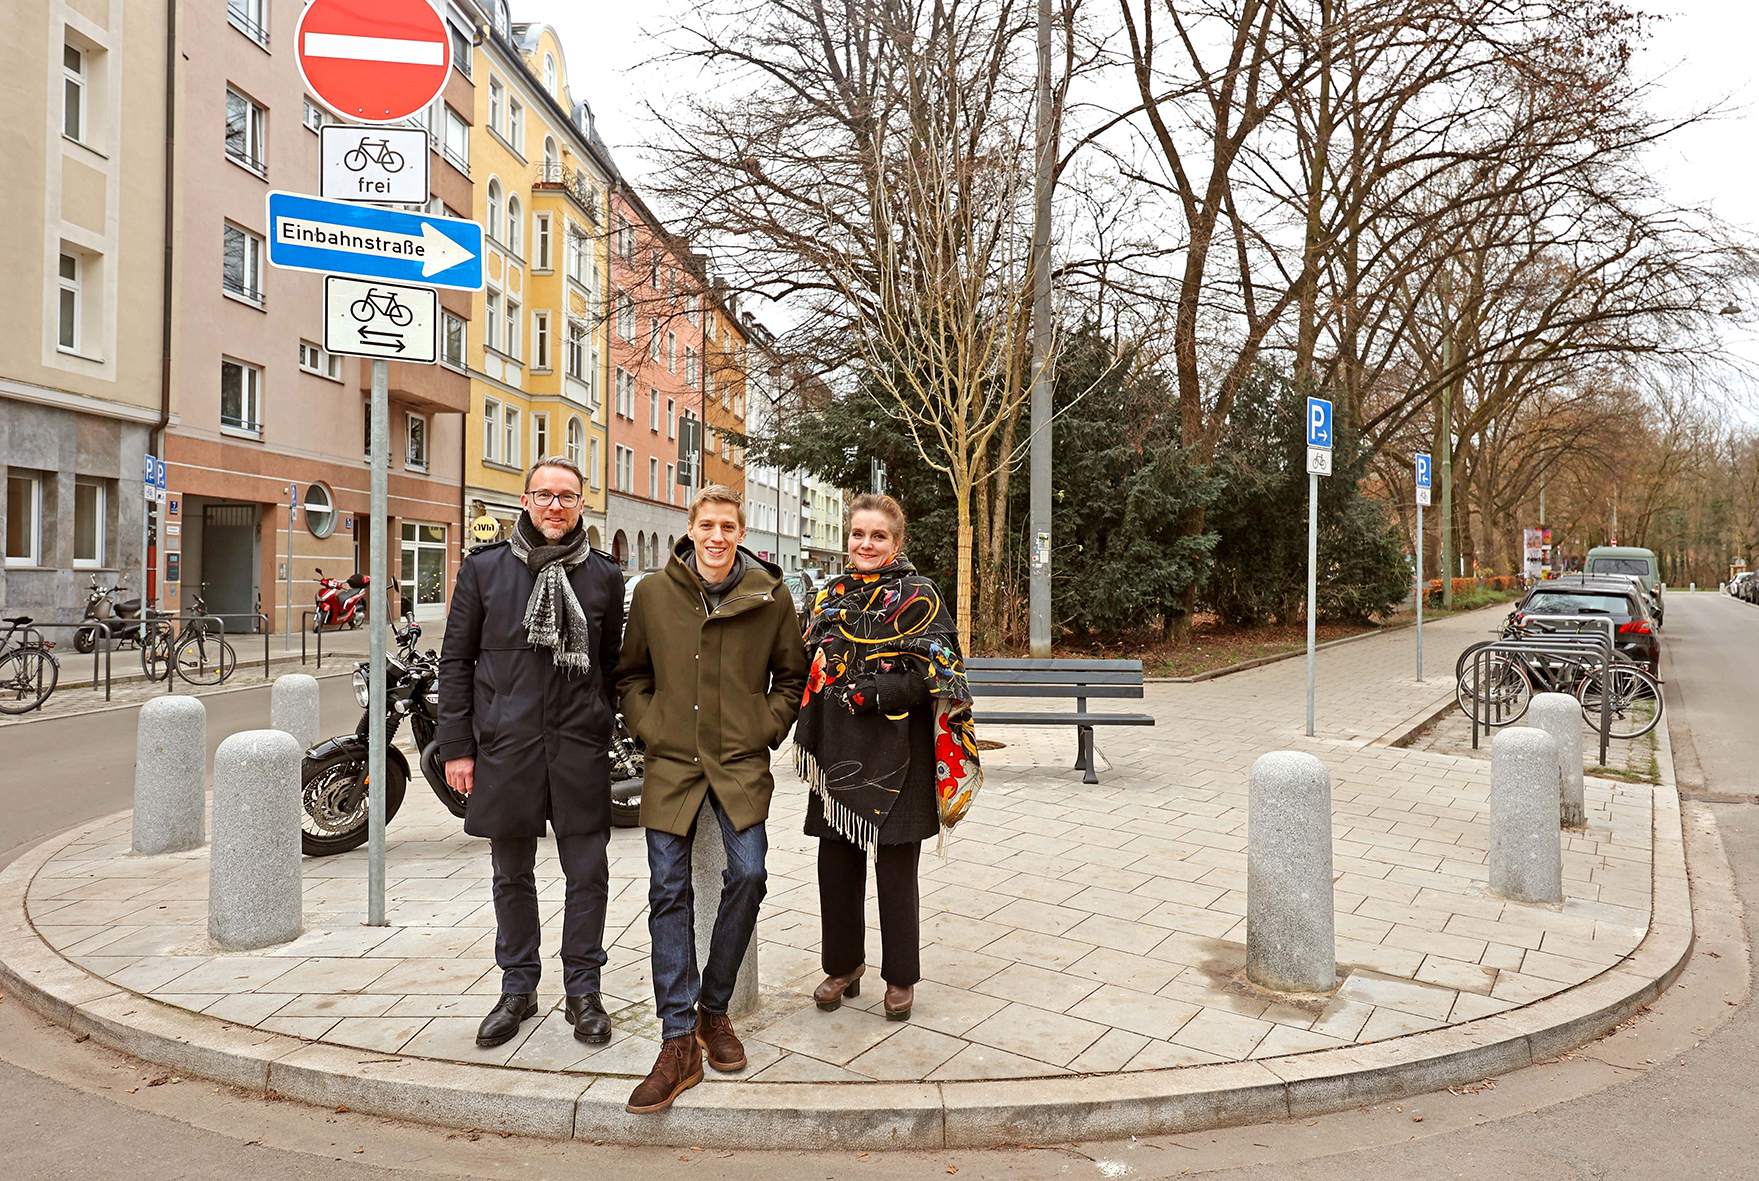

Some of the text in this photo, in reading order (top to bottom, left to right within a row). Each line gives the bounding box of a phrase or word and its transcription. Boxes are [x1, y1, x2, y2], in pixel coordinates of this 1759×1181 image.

[358, 177, 391, 194] frei
[282, 222, 425, 257] Einbahnstraße
[1311, 404, 1325, 440] P
[146, 459, 153, 480] P
[157, 464, 164, 485] P
[1418, 458, 1427, 482] P
